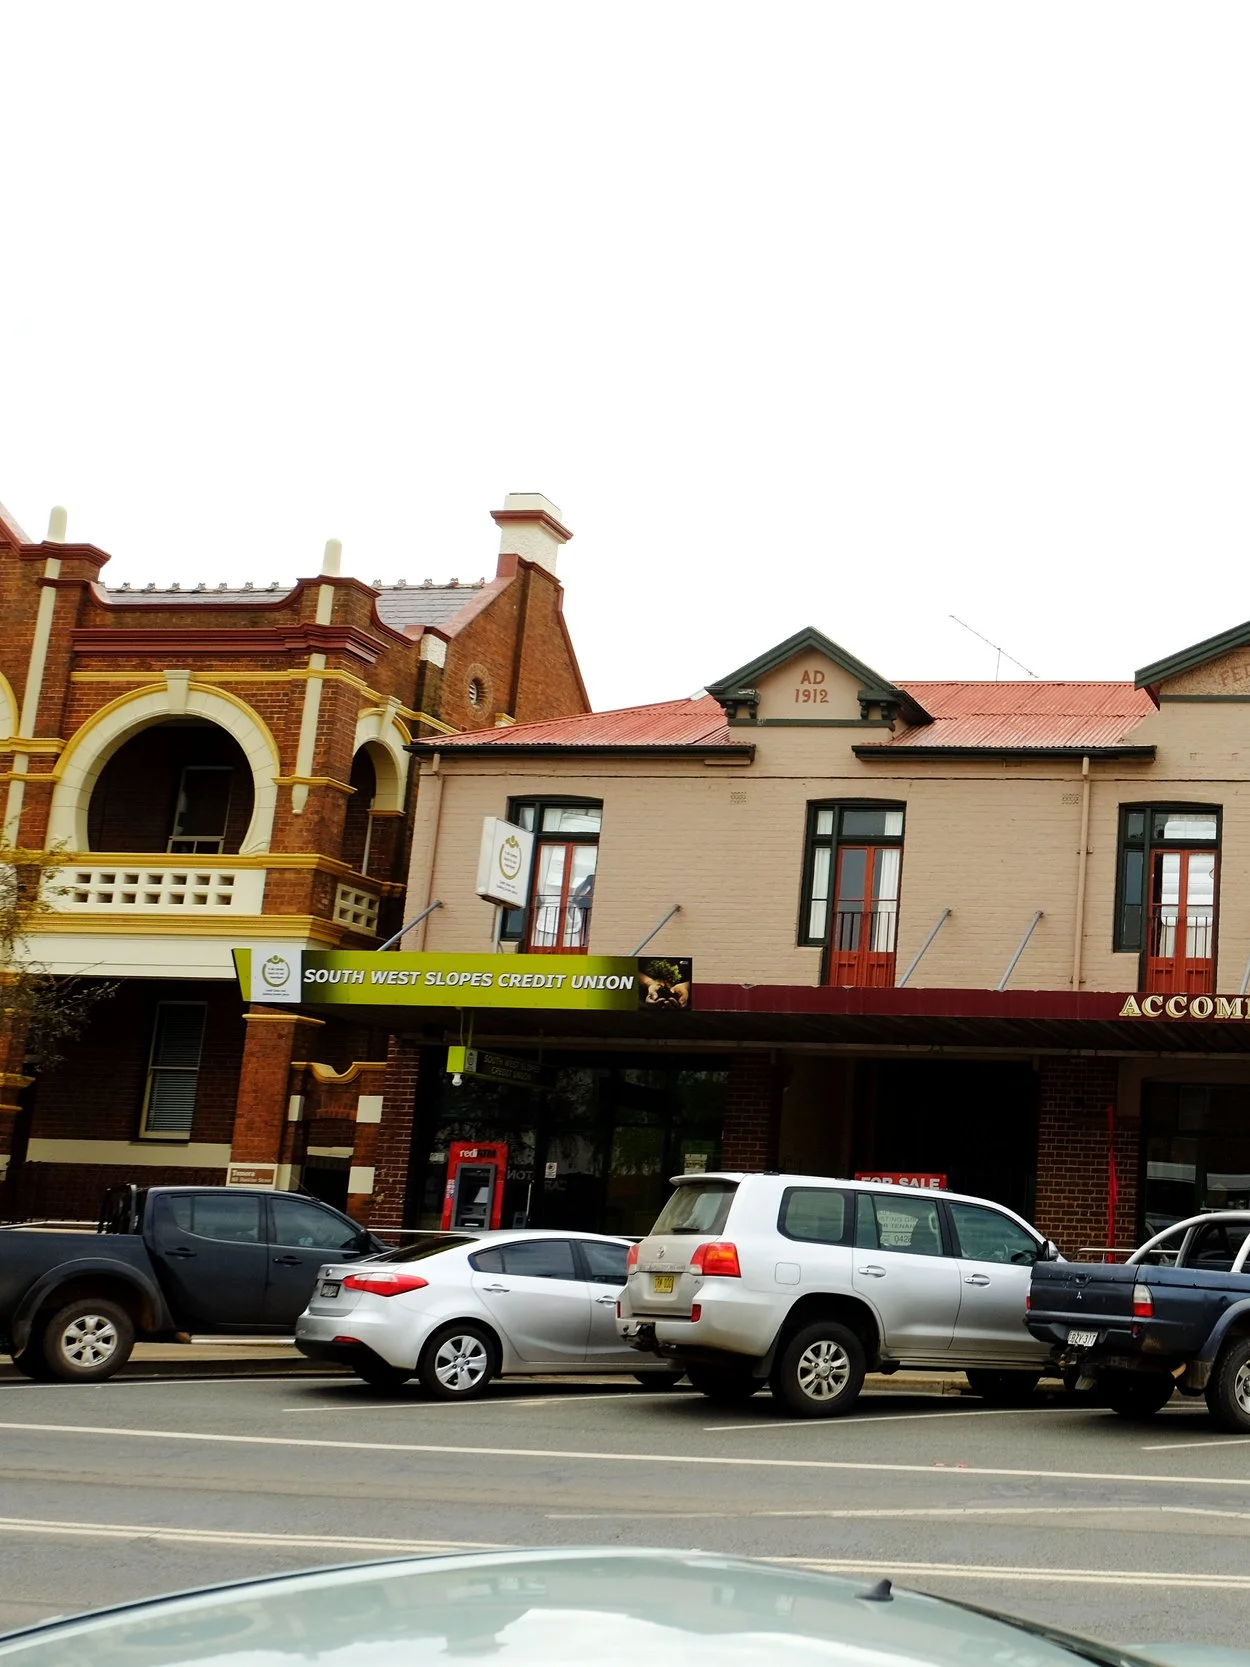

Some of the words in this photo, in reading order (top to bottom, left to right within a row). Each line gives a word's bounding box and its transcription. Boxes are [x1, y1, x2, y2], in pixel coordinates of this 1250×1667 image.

[800, 669, 825, 685] AD
[795, 688, 830, 704] 1912
[303, 968, 366, 984] SOUTH
[370, 970, 421, 986] WEST
[424, 971, 494, 987] SLOPES
[498, 973, 567, 989] CREDIT
[571, 974, 635, 990] UNION
[899, 1178, 940, 1190] SALE
